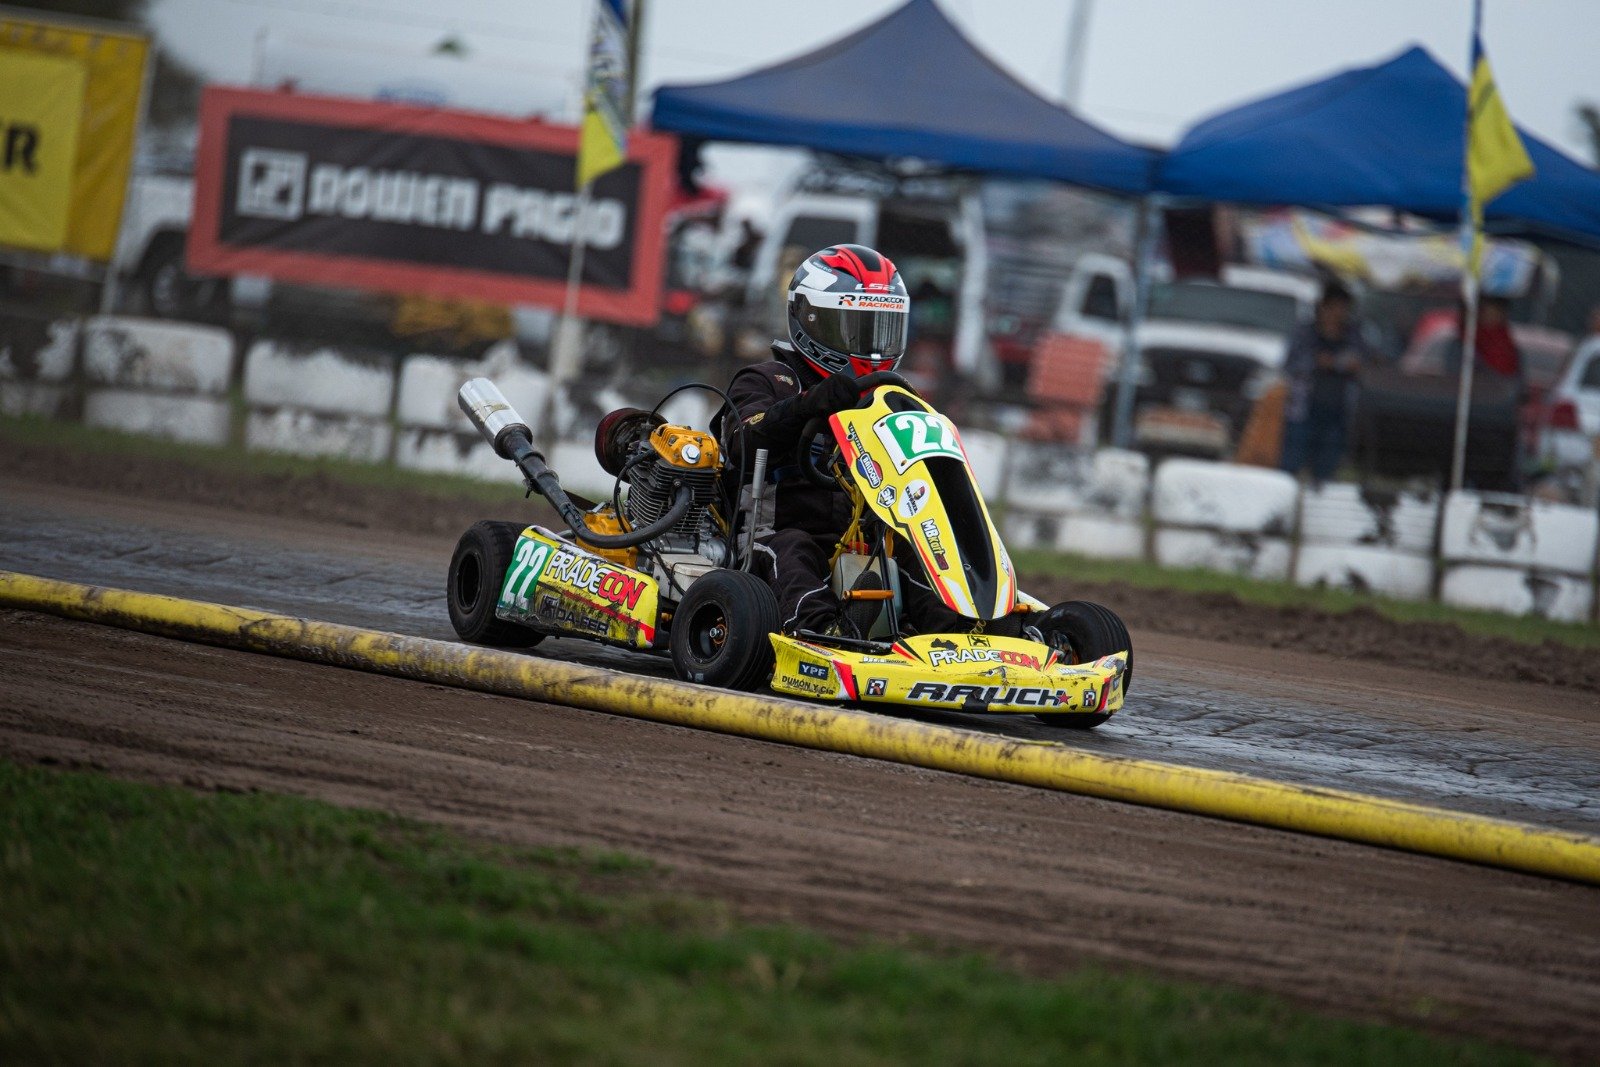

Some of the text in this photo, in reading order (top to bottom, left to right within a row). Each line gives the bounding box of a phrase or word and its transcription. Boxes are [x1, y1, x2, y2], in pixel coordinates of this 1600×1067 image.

[855, 283, 896, 292] LS2
[858, 295, 905, 304] PRADECON
[858, 301, 896, 309] RACING
[795, 330, 850, 372] LS2
[895, 414, 962, 455] 22
[502, 541, 548, 611] 22
[545, 551, 648, 611] PRADECON
[801, 664, 826, 677] YPF
[929, 650, 1042, 672] PRADECON
[906, 682, 1061, 706] RAUCH
